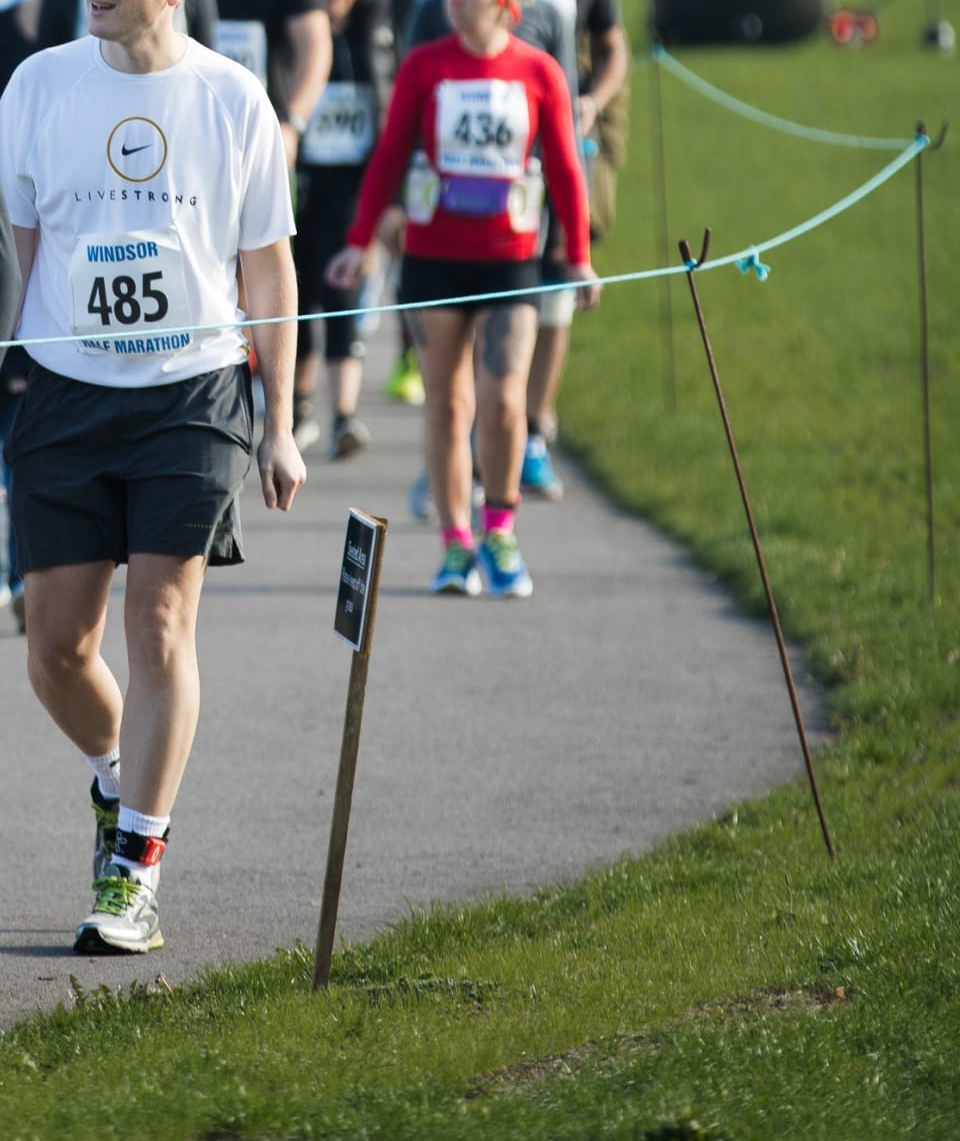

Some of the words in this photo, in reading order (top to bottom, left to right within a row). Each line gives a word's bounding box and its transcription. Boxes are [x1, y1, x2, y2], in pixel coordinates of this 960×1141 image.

[454, 110, 512, 147] 436
[74, 189, 197, 206] LIVESTRONG
[87, 241, 158, 262] WINDSOR
[87, 270, 169, 326] 485
[114, 332, 190, 354] MARATHON
